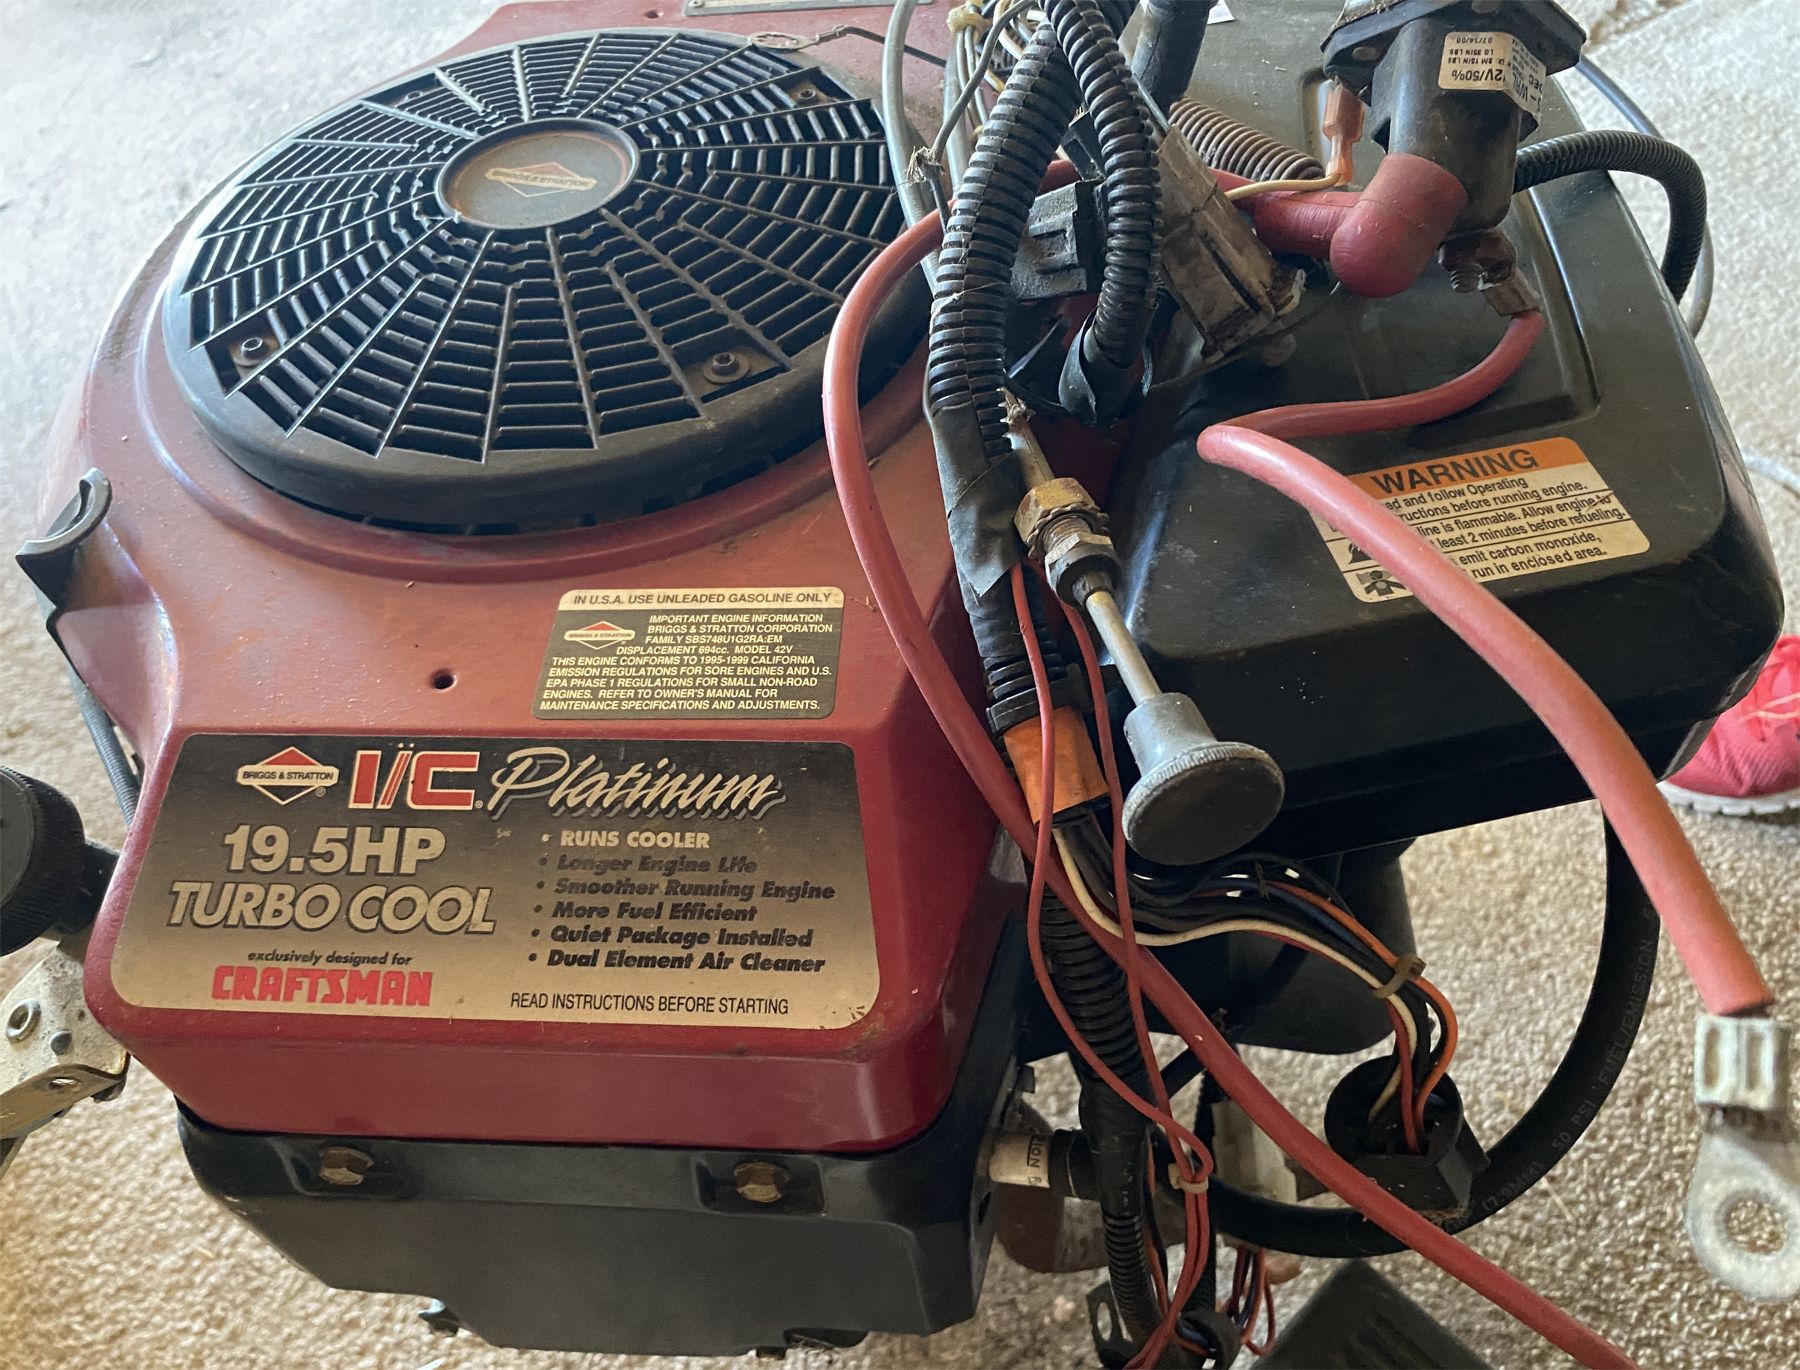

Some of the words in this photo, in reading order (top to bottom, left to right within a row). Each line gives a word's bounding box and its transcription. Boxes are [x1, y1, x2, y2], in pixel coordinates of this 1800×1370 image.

[1370, 448, 1539, 494] WARNING
[1403, 494, 1426, 507] and
[1428, 489, 1466, 504] follow
[1467, 478, 1528, 496] Operating
[1451, 497, 1491, 512] before
[1492, 490, 1542, 505] running
[1542, 482, 1588, 496] engine.
[1441, 522, 1454, 533] is
[1455, 511, 1521, 530] flammable.
[1521, 505, 1555, 518] Allow
[1556, 497, 1595, 512] engine
[1596, 494, 1611, 504] to
[1437, 533, 1469, 548] least
[1468, 533, 1478, 542] 2
[1479, 524, 1527, 541] minutes
[1527, 518, 1567, 532] before
[1568, 508, 1626, 524] refueling.
[1459, 551, 1488, 565] emit
[1489, 544, 1533, 559] carbon
[1534, 531, 1602, 551] monoxide,
[1471, 565, 1494, 578] run
[1494, 562, 1509, 574] in
[1511, 550, 1575, 571] enclosed
[1574, 546, 1607, 559] area.
[574, 595, 586, 604] IN
[590, 595, 625, 604] U.S.A.
[628, 595, 654, 604] USE
[657, 594, 725, 604] UNLEADED
[729, 593, 793, 603] GASOLINE
[796, 592, 831, 602] ONLY
[648, 625, 687, 633] BRIGGS
[689, 625, 696, 633] &
[700, 624, 754, 633] STRATTON
[757, 624, 833, 632] CORPORATION
[650, 615, 709, 623] IMPORTANT
[711, 614, 750, 622] ENGINE
[752, 614, 823, 622] INFORMATION
[616, 646, 697, 654] DISPLACEMENT
[698, 646, 729, 654] 694cc.
[734, 646, 772, 654] MODEL
[645, 636, 683, 644] FAMILY
[549, 668, 600, 676] EMISSION
[602, 667, 677, 676] REGULATIONS
[680, 667, 702, 675] FOR
[705, 667, 734, 675] SORE
[736, 667, 784, 675] ENGINES
[786, 667, 809, 675] AND
[812, 667, 832, 675] U.S.
[552, 657, 576, 665] THIS
[578, 657, 617, 665] ENGINE
[620, 656, 680, 665] CONFORMS
[683, 656, 697, 664] TO
[700, 656, 749, 664] 1995-1999
[751, 656, 815, 664] CALIFORNIA
[543, 690, 593, 698] ENGINES.
[599, 690, 634, 698] REFER
[637, 690, 652, 698] TO
[654, 689, 704, 698] OWNER'S
[706, 689, 752, 698] MANUAL
[755, 689, 778, 697] FOR
[546, 679, 567, 687] EPA
[570, 679, 607, 687] PHASE
[610, 679, 614, 687] 1
[617, 678, 694, 687] REGULATIONS
[696, 678, 718, 686] FOR
[721, 678, 757, 686] SMALL
[759, 678, 817, 686] NON-ROAD
[540, 701, 618, 710] MAINTENANCE
[620, 700, 710, 710] SPECIFICATIONS
[712, 700, 735, 709] AND
[738, 700, 820, 709] ADJUSTMENTS.
[242, 771, 276, 780] BRIGGS
[278, 771, 285, 780] &
[287, 770, 334, 781] STRATTON
[488, 747, 785, 818] Platinum
[224, 824, 446, 876] 19.5HP
[560, 830, 620, 848] RUNS
[626, 831, 710, 849] COOLER
[556, 854, 632, 876] Longer
[638, 855, 712, 876] Engine
[718, 856, 758, 874] Life
[554, 878, 658, 896] Smoother
[664, 880, 755, 902] Running
[761, 881, 836, 903] Engine
[167, 881, 342, 930] TURBO
[349, 884, 498, 935] COOL
[552, 902, 610, 919] More
[617, 904, 663, 920] Fuel
[667, 904, 758, 922] Efficient
[550, 926, 611, 944] Quiet
[616, 926, 711, 949] Package
[717, 928, 813, 947] Installed
[248, 949, 323, 966] exclusively
[325, 951, 388, 968] designed
[391, 952, 412, 966] for
[547, 949, 600, 967] Dual
[604, 950, 694, 969] Element
[698, 953, 734, 970] Air
[740, 954, 826, 973] Cleaner
[211, 965, 434, 1007] CRAFTSMAN
[510, 993, 548, 1009] READ
[552, 994, 654, 1011] INSTRUCTIONS
[658, 996, 714, 1013] BEFORE
[718, 998, 789, 1015] STARTING
[1551, 1130, 1573, 1152] 50
[1570, 1100, 1597, 1128] PSI
[1597, 940, 1654, 1087] FUEL/EMISSION
